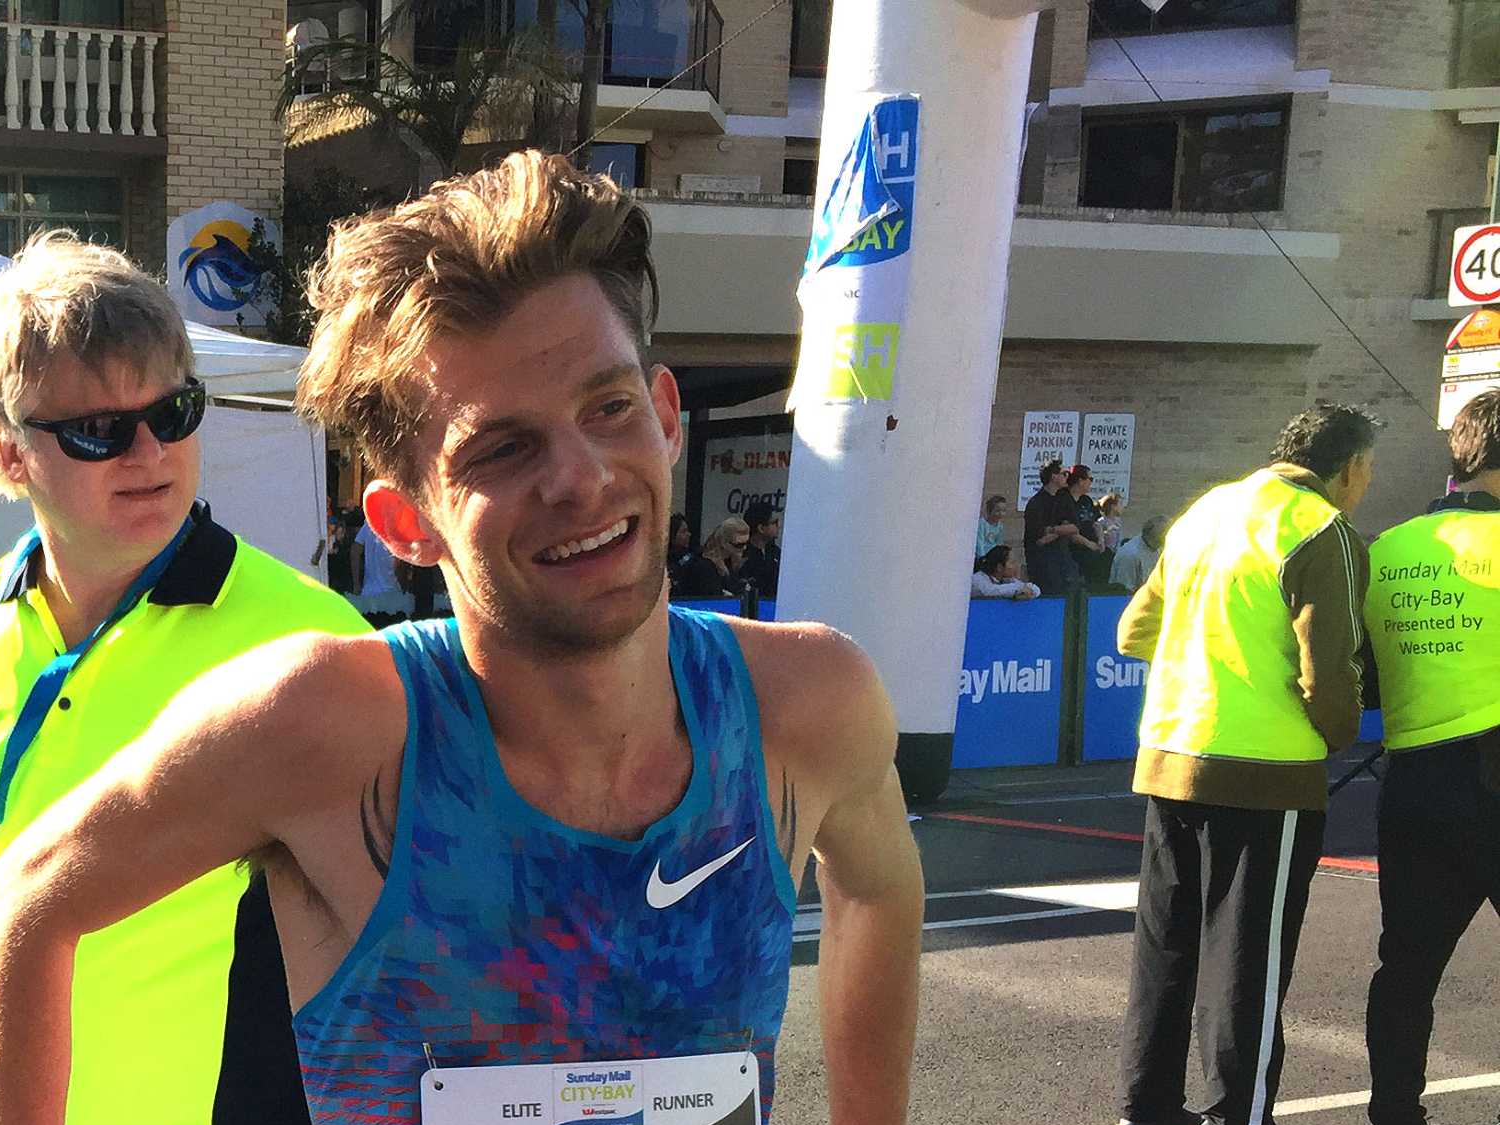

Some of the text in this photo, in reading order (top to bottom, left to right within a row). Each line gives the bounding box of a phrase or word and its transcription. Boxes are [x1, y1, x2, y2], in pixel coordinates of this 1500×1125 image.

[1029, 422, 1073, 434] PRIVATE
[1090, 424, 1128, 436] PRIVATE
[1027, 436, 1073, 448] PARKING
[1088, 439, 1128, 451] PARKING
[1034, 451, 1063, 463] AREA
[1094, 453, 1120, 465] AREA
[1378, 559, 1492, 582] Sunday Mail
[1390, 589, 1465, 611] City-Bay
[1384, 614, 1483, 632] Presented by
[1399, 640, 1465, 655] Westpac
[992, 658, 1052, 694] Mail
[1095, 655, 1150, 689] Sun
[566, 1070, 631, 1085] Sunday Mail
[560, 1084, 635, 1102] CITY-BAY
[653, 1093, 714, 1111] RUNNER
[502, 1103, 542, 1118] ELITE
